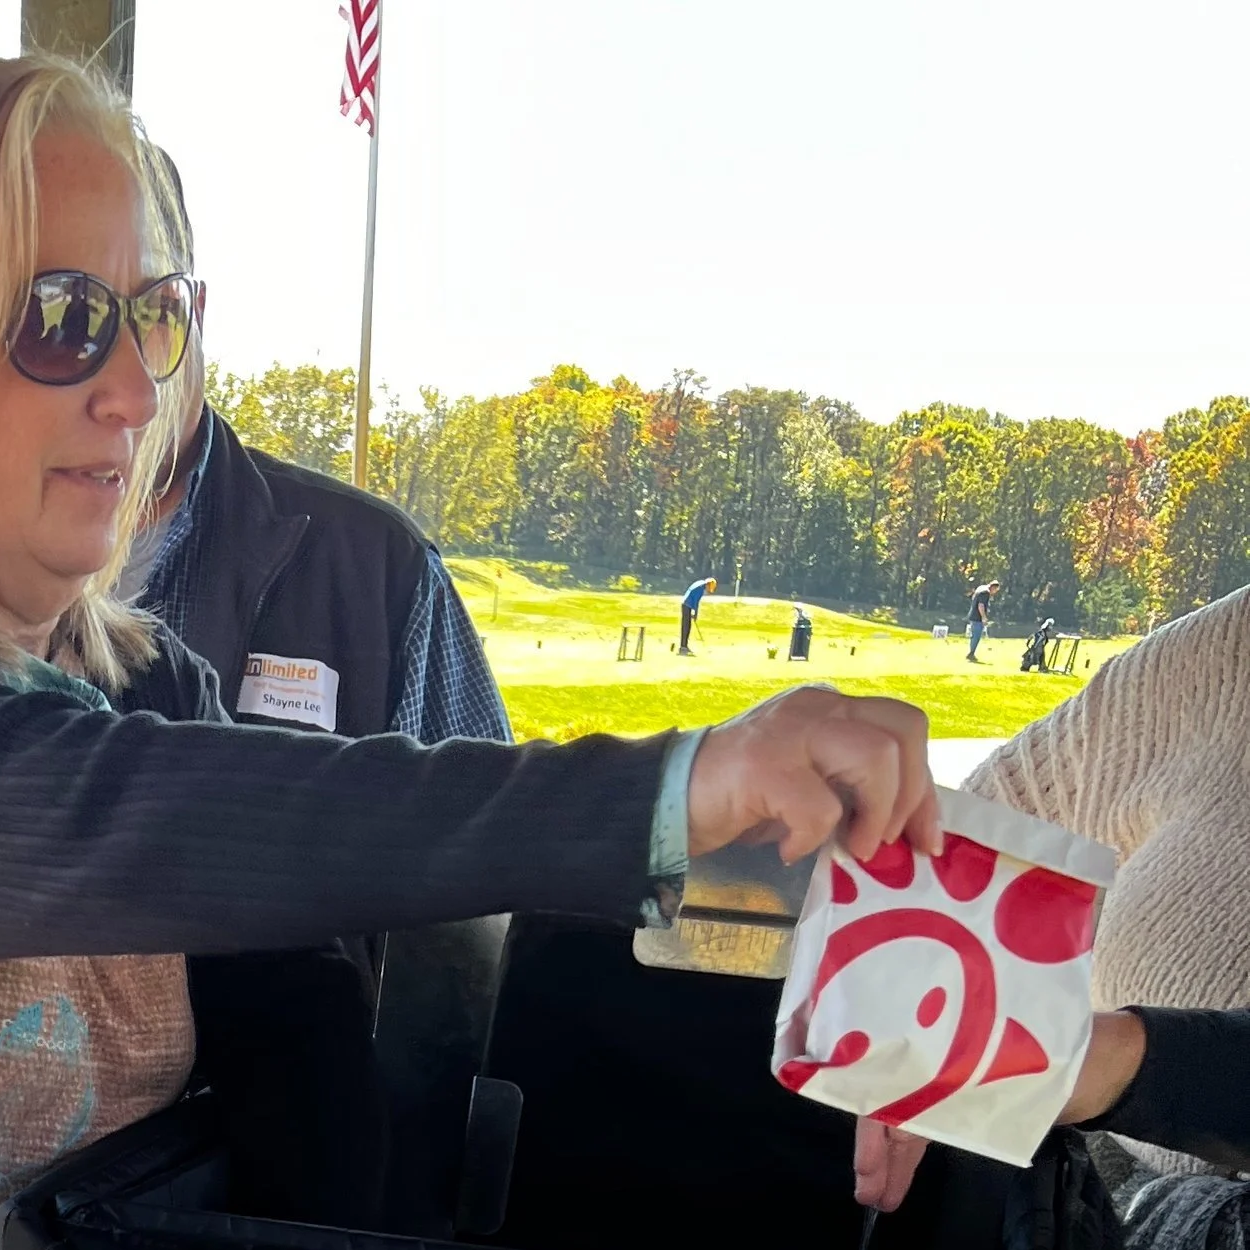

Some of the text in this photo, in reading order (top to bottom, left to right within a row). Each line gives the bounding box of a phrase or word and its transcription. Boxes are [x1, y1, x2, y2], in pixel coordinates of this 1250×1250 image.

[244, 658, 318, 680] nlimited
[262, 693, 321, 713] Shayne Lee
